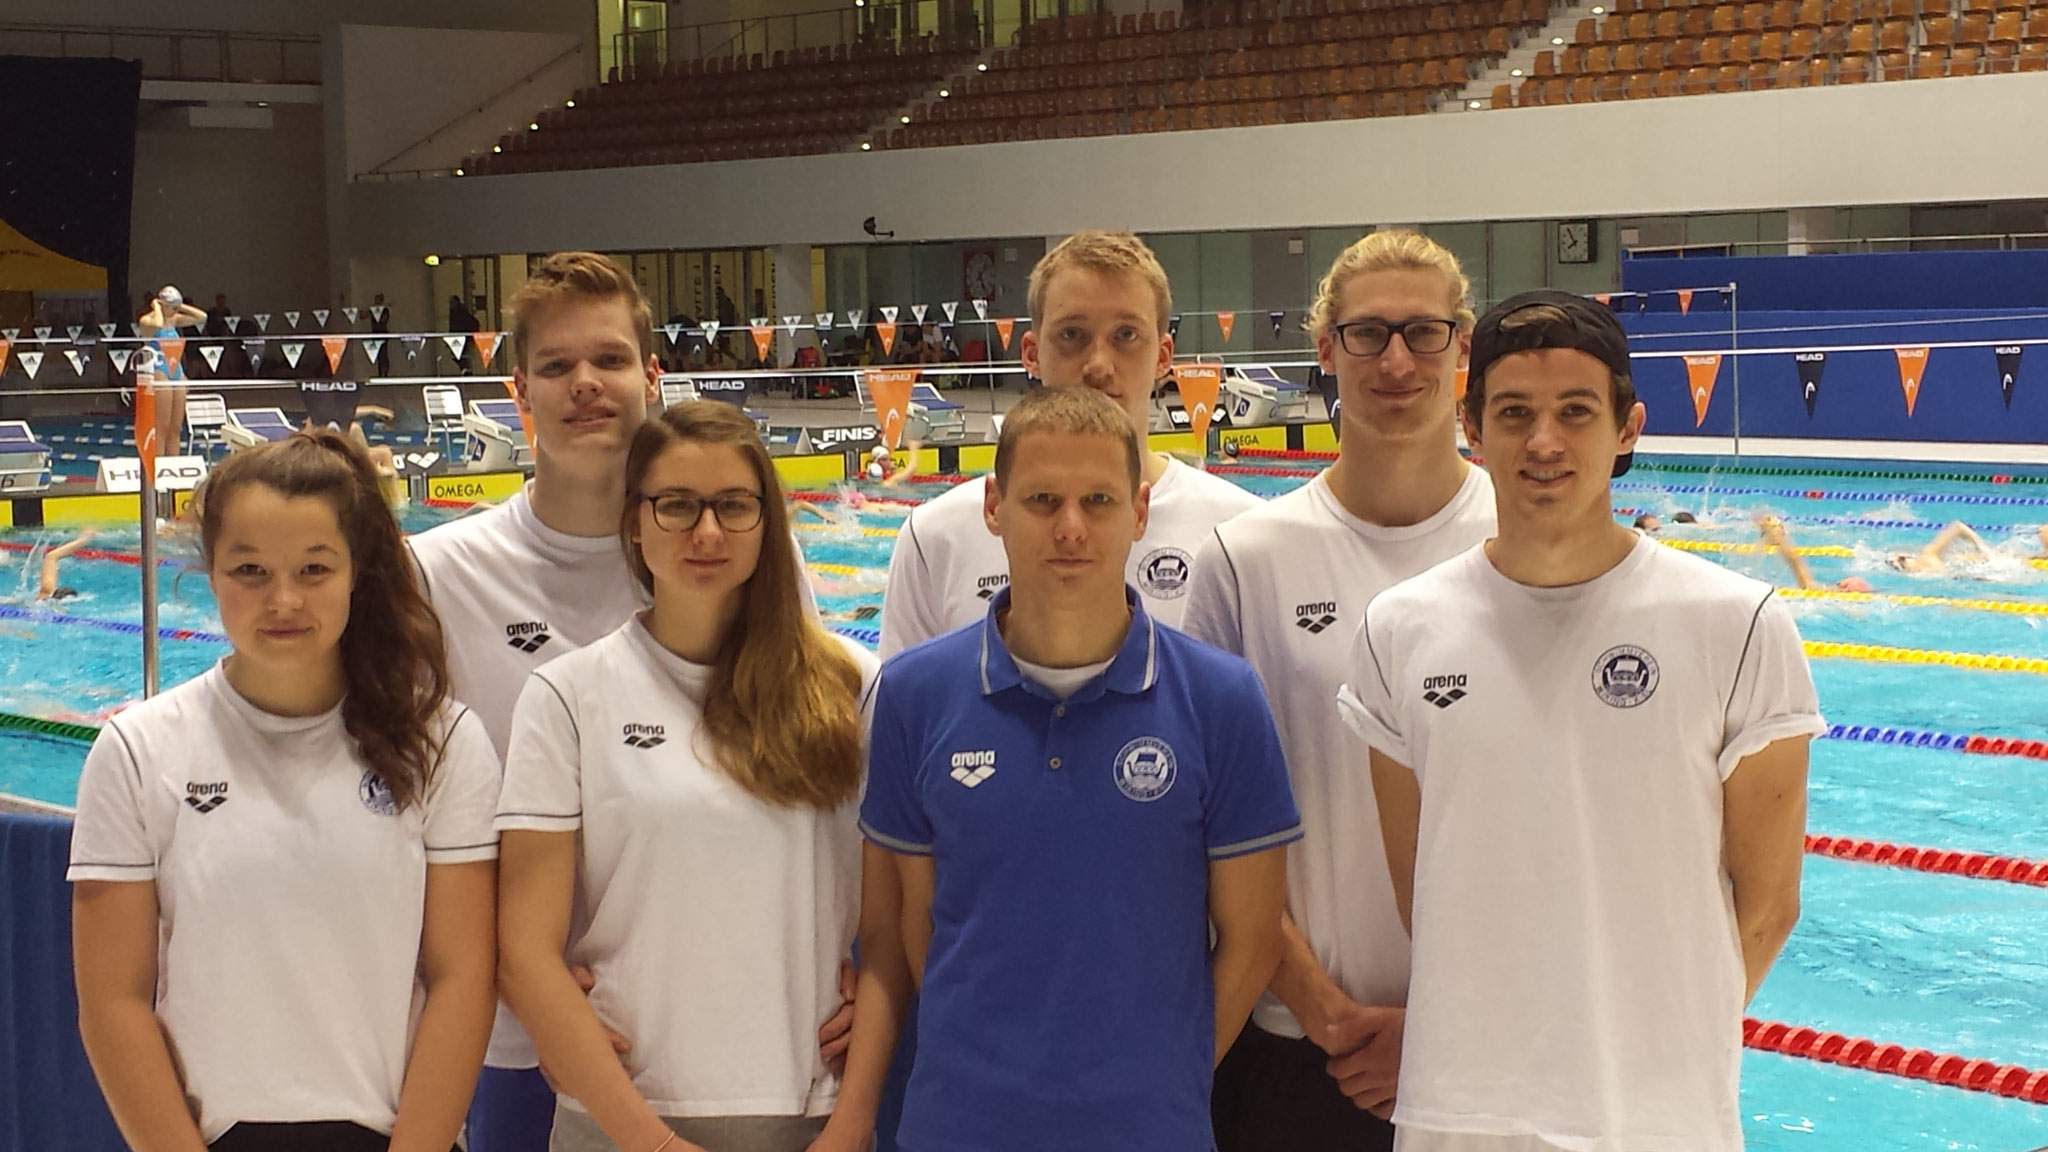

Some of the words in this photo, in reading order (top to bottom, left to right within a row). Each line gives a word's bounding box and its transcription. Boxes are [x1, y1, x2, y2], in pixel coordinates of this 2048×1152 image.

[869, 373, 911, 382] HEAD
[1177, 369, 1217, 378] HEAD
[301, 381, 357, 392] HEAD
[699, 380, 745, 391] HEAD
[822, 427, 876, 443] FINIS
[109, 467, 201, 481] HAD
[434, 483, 484, 498] OMEGA
[977, 574, 1009, 588] aren
[1296, 601, 1337, 617] arena
[506, 621, 549, 636] arena
[1423, 673, 1468, 690] arena
[623, 723, 665, 736] arena
[951, 750, 996, 767] arena
[186, 781, 229, 794] arena
